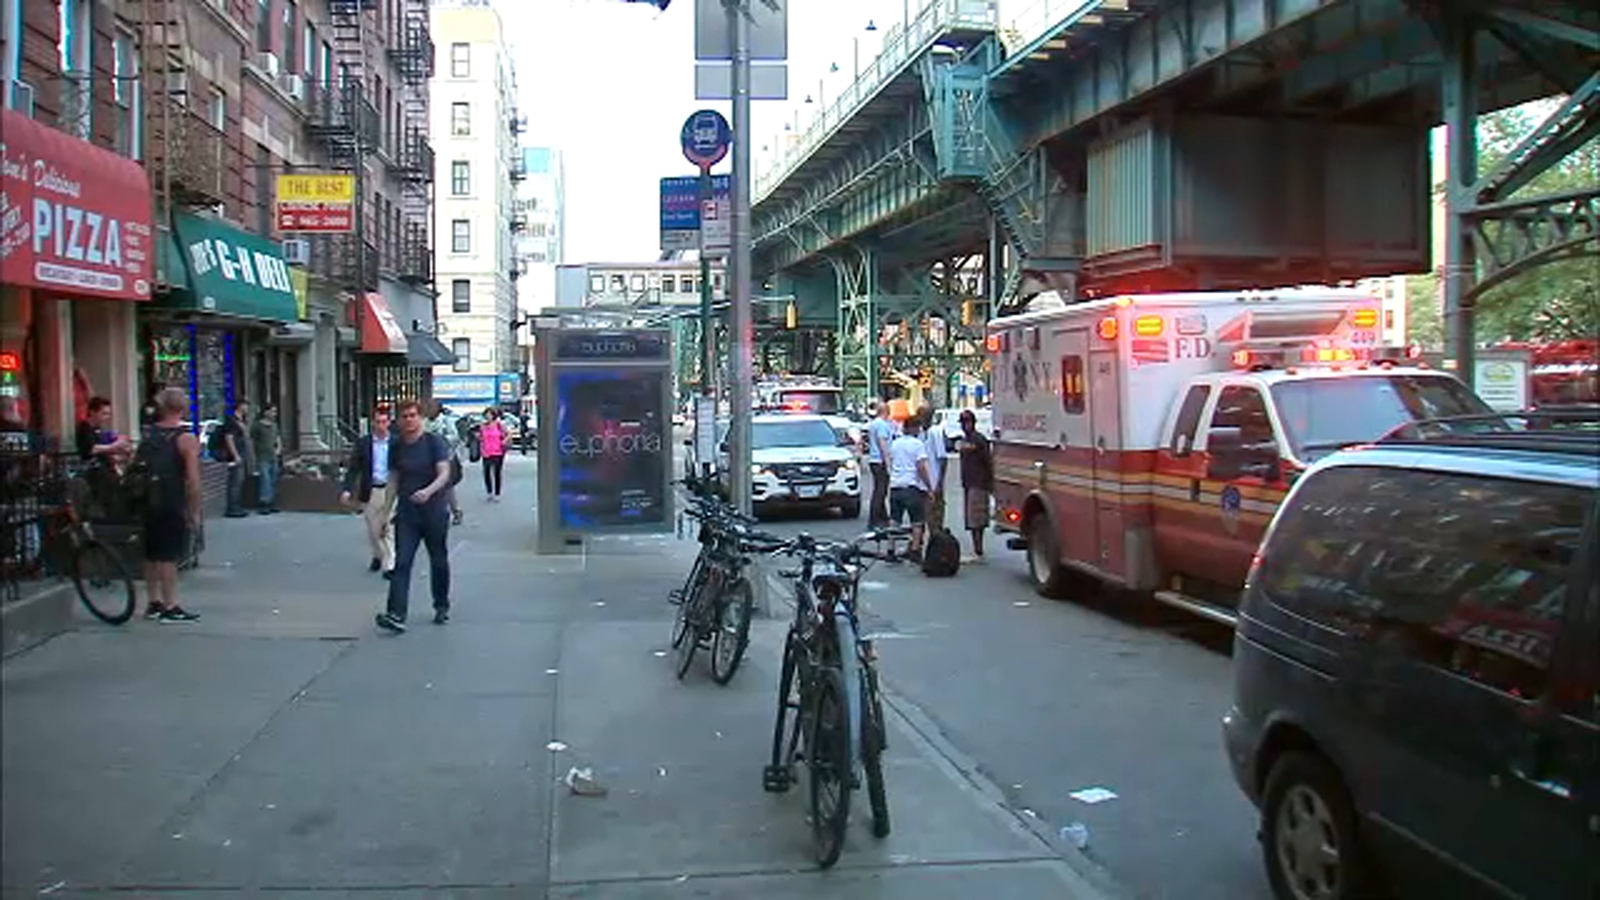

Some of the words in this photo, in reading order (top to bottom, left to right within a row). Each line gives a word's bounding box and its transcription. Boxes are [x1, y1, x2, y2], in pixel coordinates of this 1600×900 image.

[288, 179, 310, 195] THE
[315, 179, 345, 196] BEST
[33, 197, 121, 268] PIZZA
[253, 251, 292, 293] DELI
[1173, 337, 1218, 359] F.D.
[559, 433, 661, 459] euphoria
